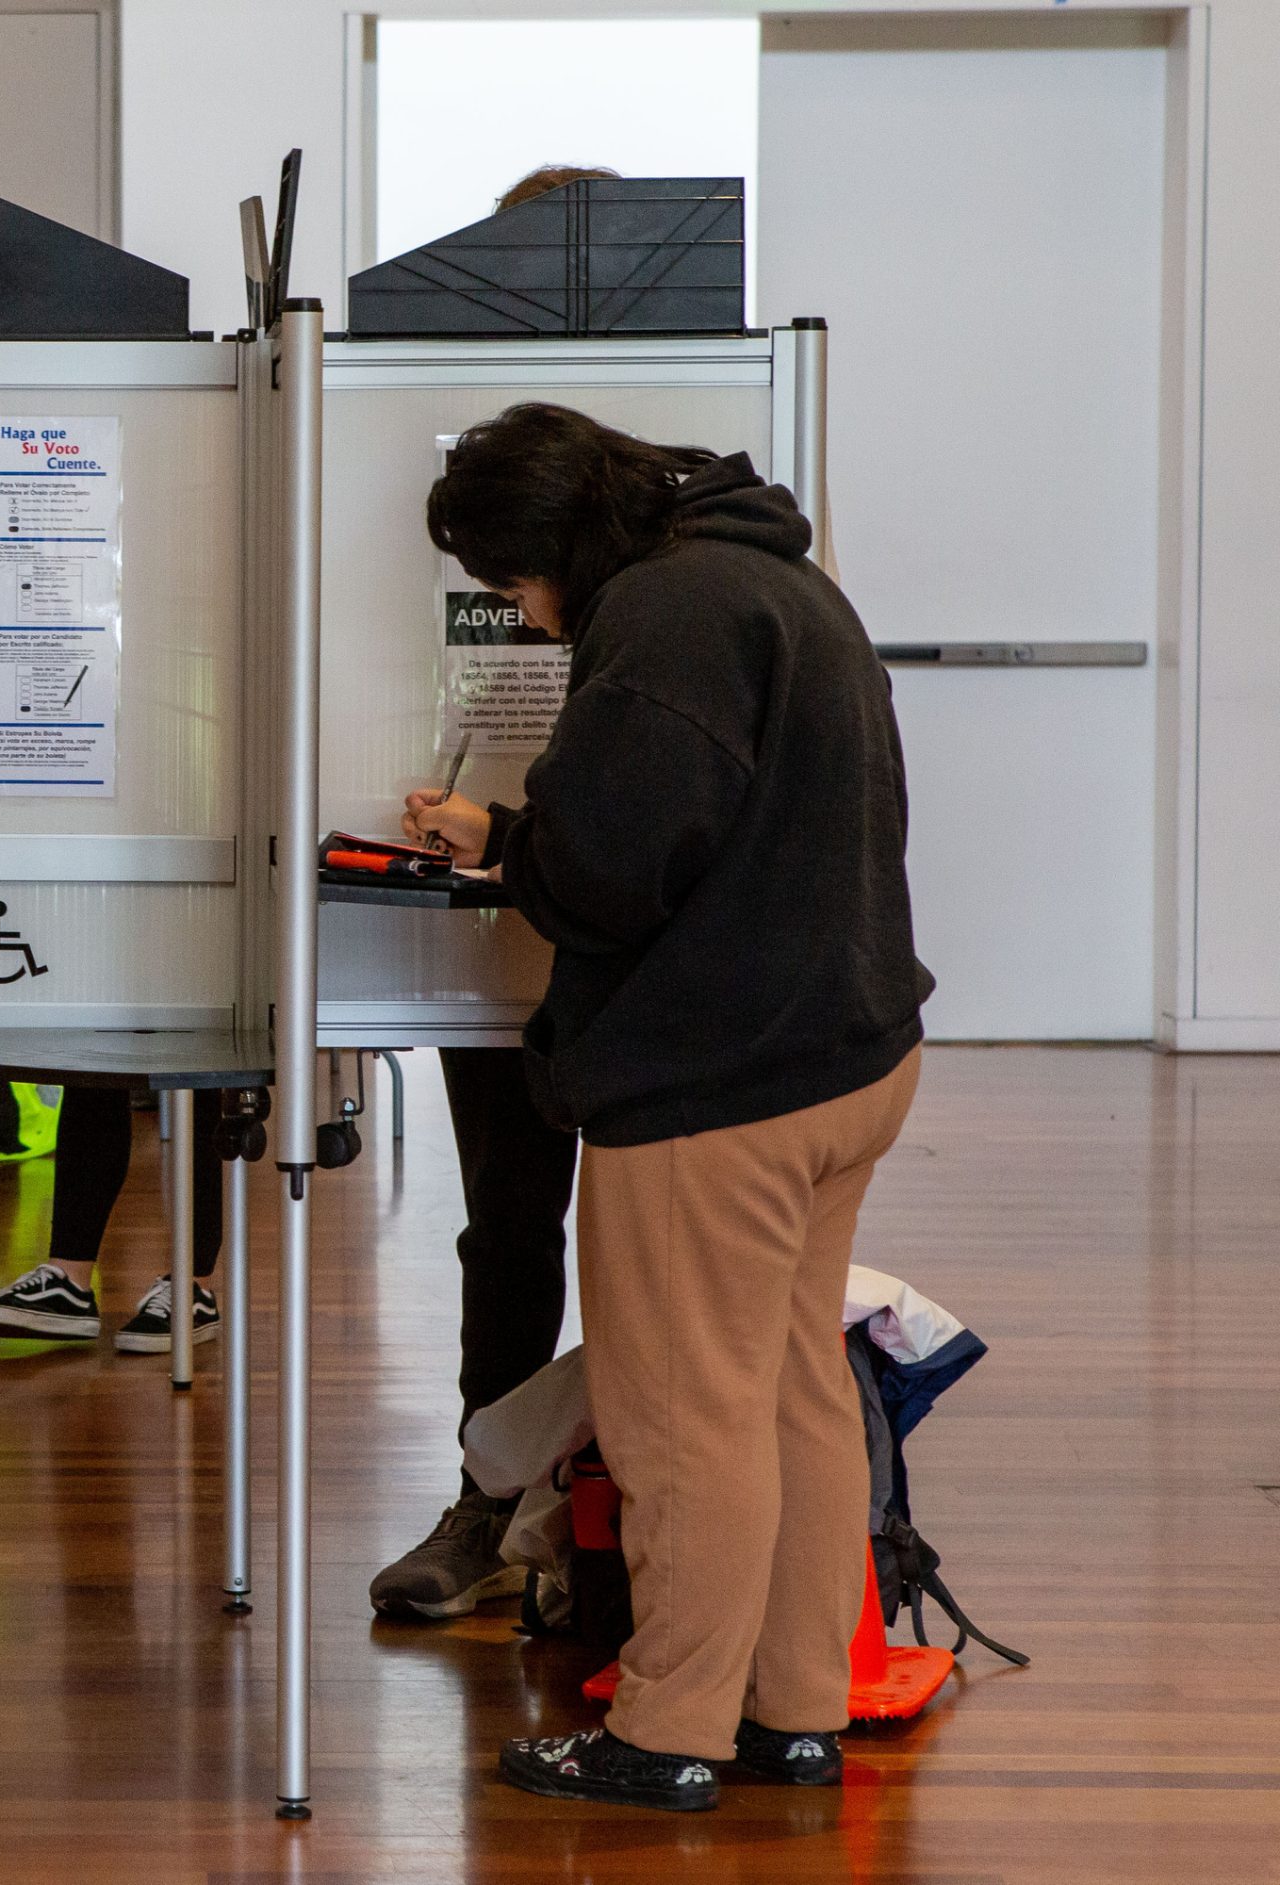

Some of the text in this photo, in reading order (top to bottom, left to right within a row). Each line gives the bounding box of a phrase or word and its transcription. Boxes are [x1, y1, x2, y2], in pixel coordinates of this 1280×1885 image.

[0, 427, 66, 440] Haga que
[22, 442, 80, 454] Su Voto
[47, 458, 101, 470] Cuente.
[507, 684, 521, 692] del
[529, 697, 559, 706] equipo
[459, 722, 506, 730] constituye
[522, 721, 547, 729] delito
